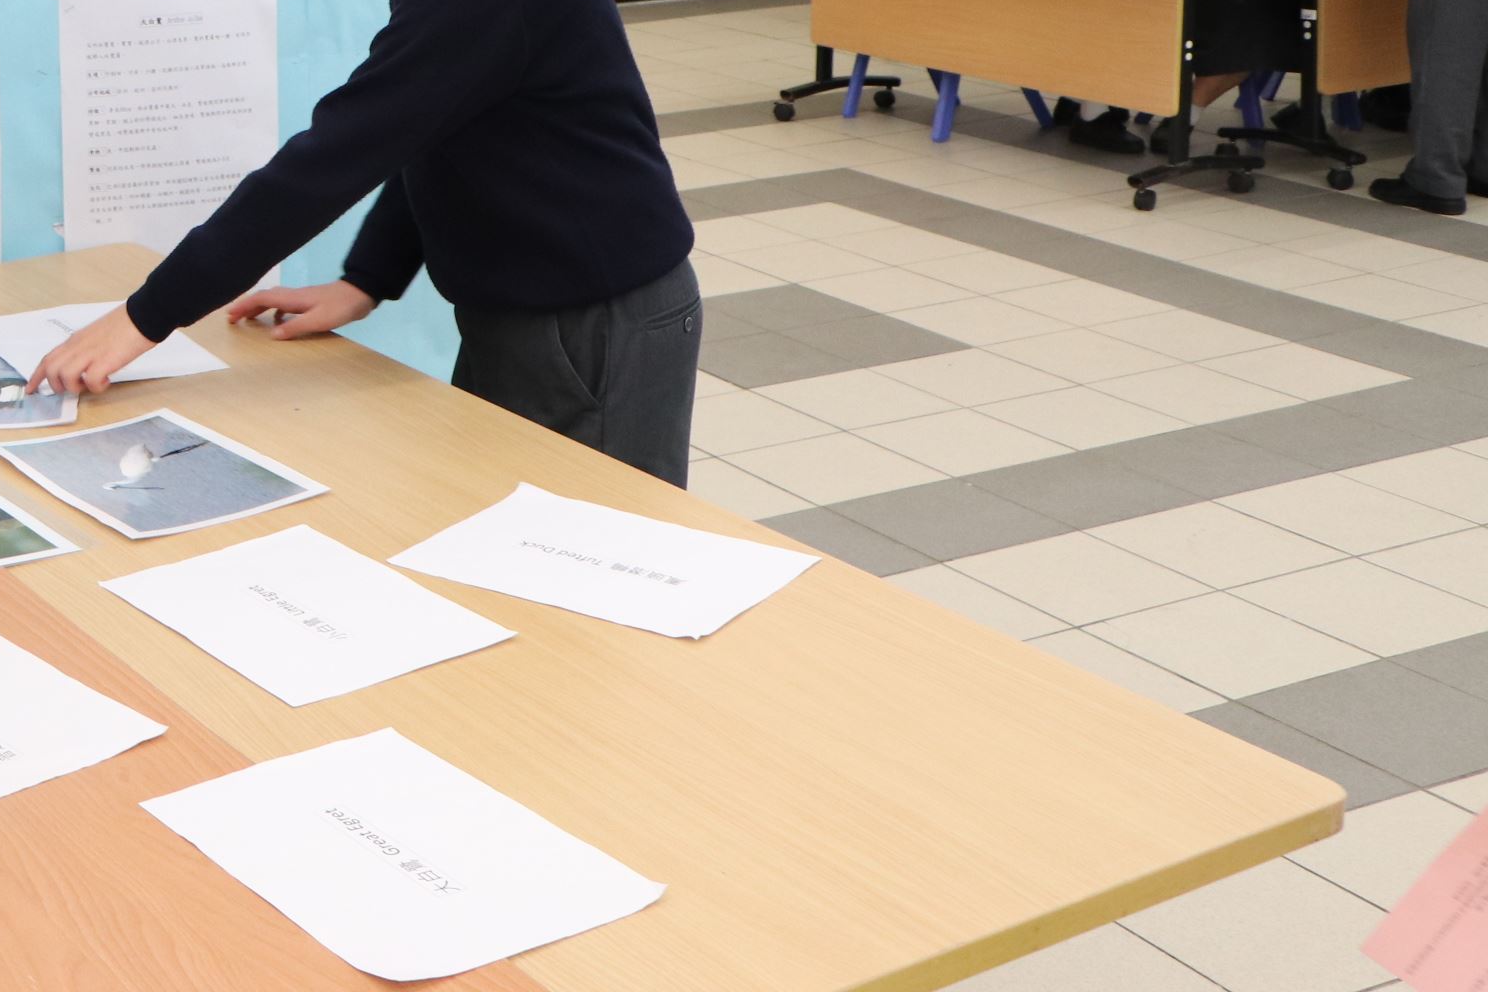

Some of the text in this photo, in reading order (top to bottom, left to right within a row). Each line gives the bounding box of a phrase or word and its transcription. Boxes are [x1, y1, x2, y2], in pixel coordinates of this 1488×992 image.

[520, 539, 556, 554] Duck
[556, 549, 602, 566] Tufted
[325, 807, 364, 832] Egret
[360, 830, 401, 856] Great
